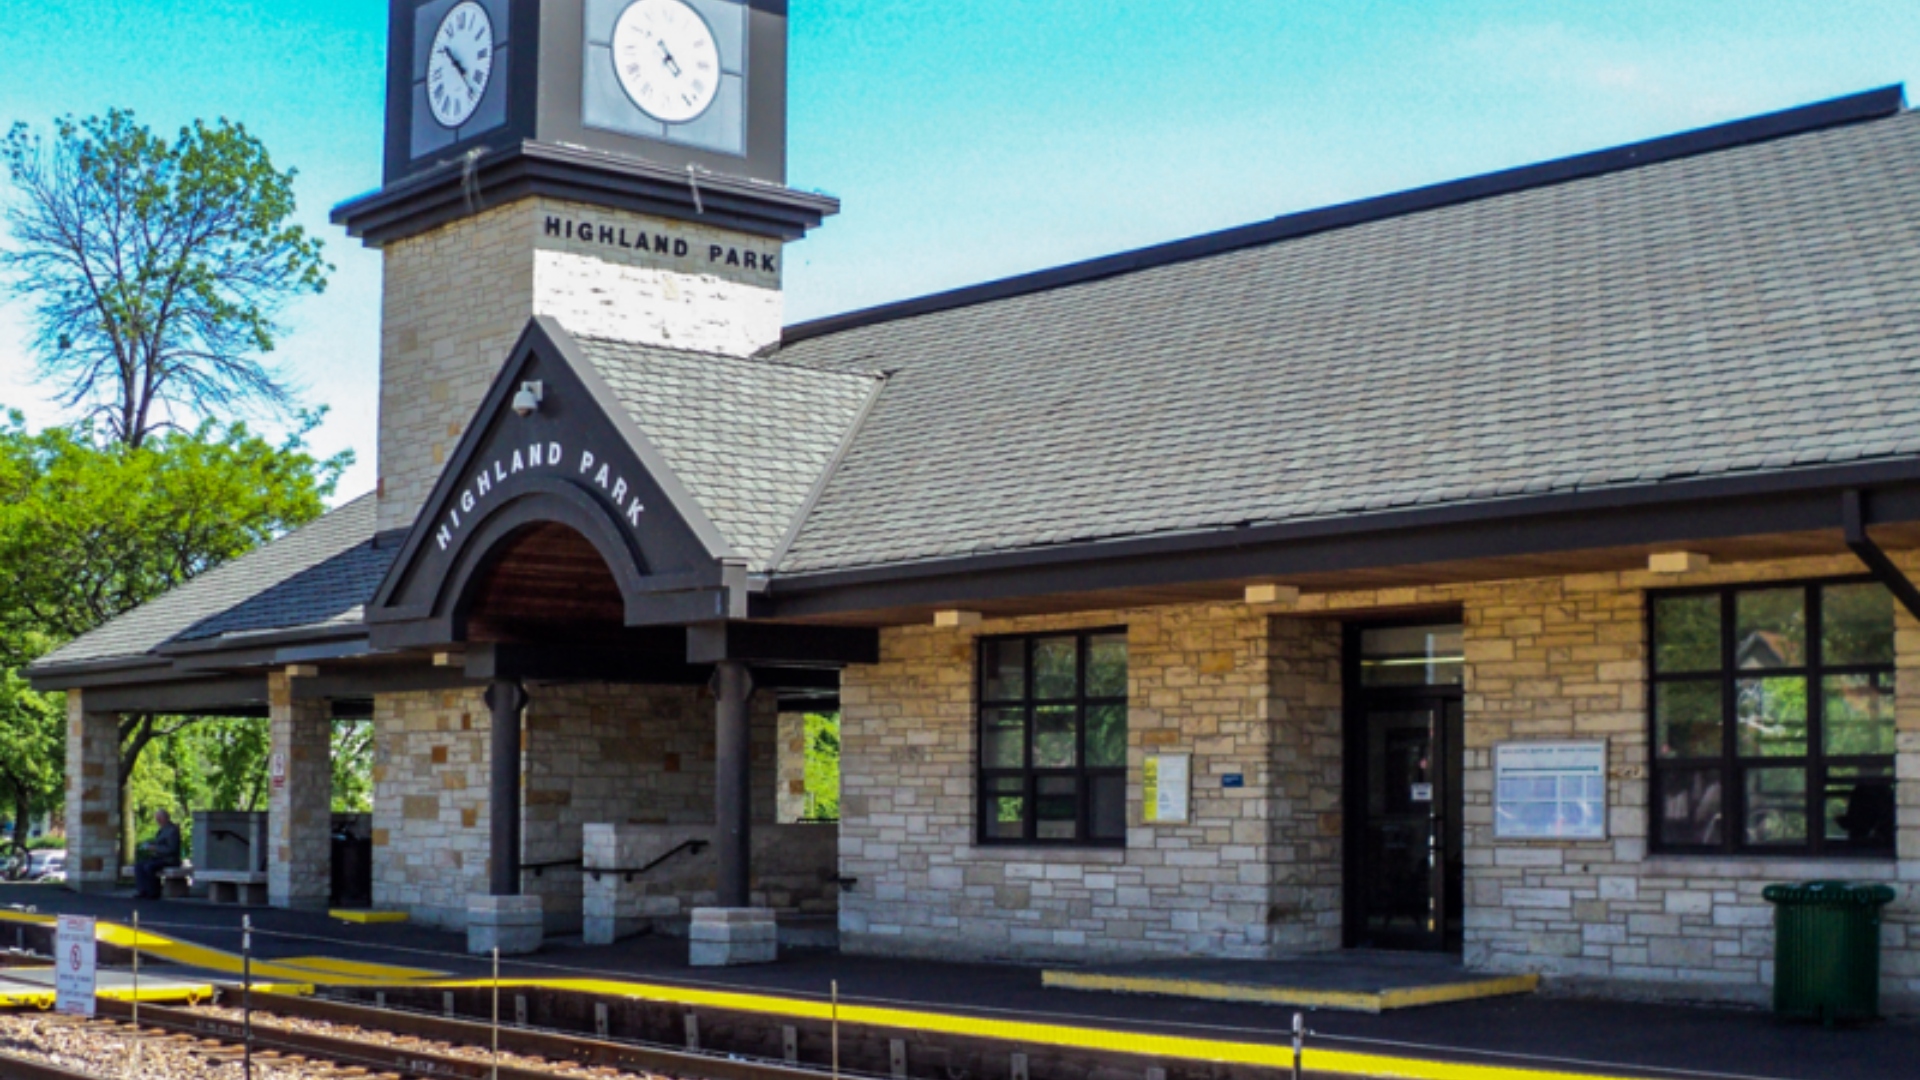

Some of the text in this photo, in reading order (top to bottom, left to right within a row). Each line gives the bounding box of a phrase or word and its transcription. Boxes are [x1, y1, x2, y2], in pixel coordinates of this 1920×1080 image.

[544, 215, 776, 273] HIGHLAND PARK
[435, 441, 645, 551] HIGHLAND PARK
